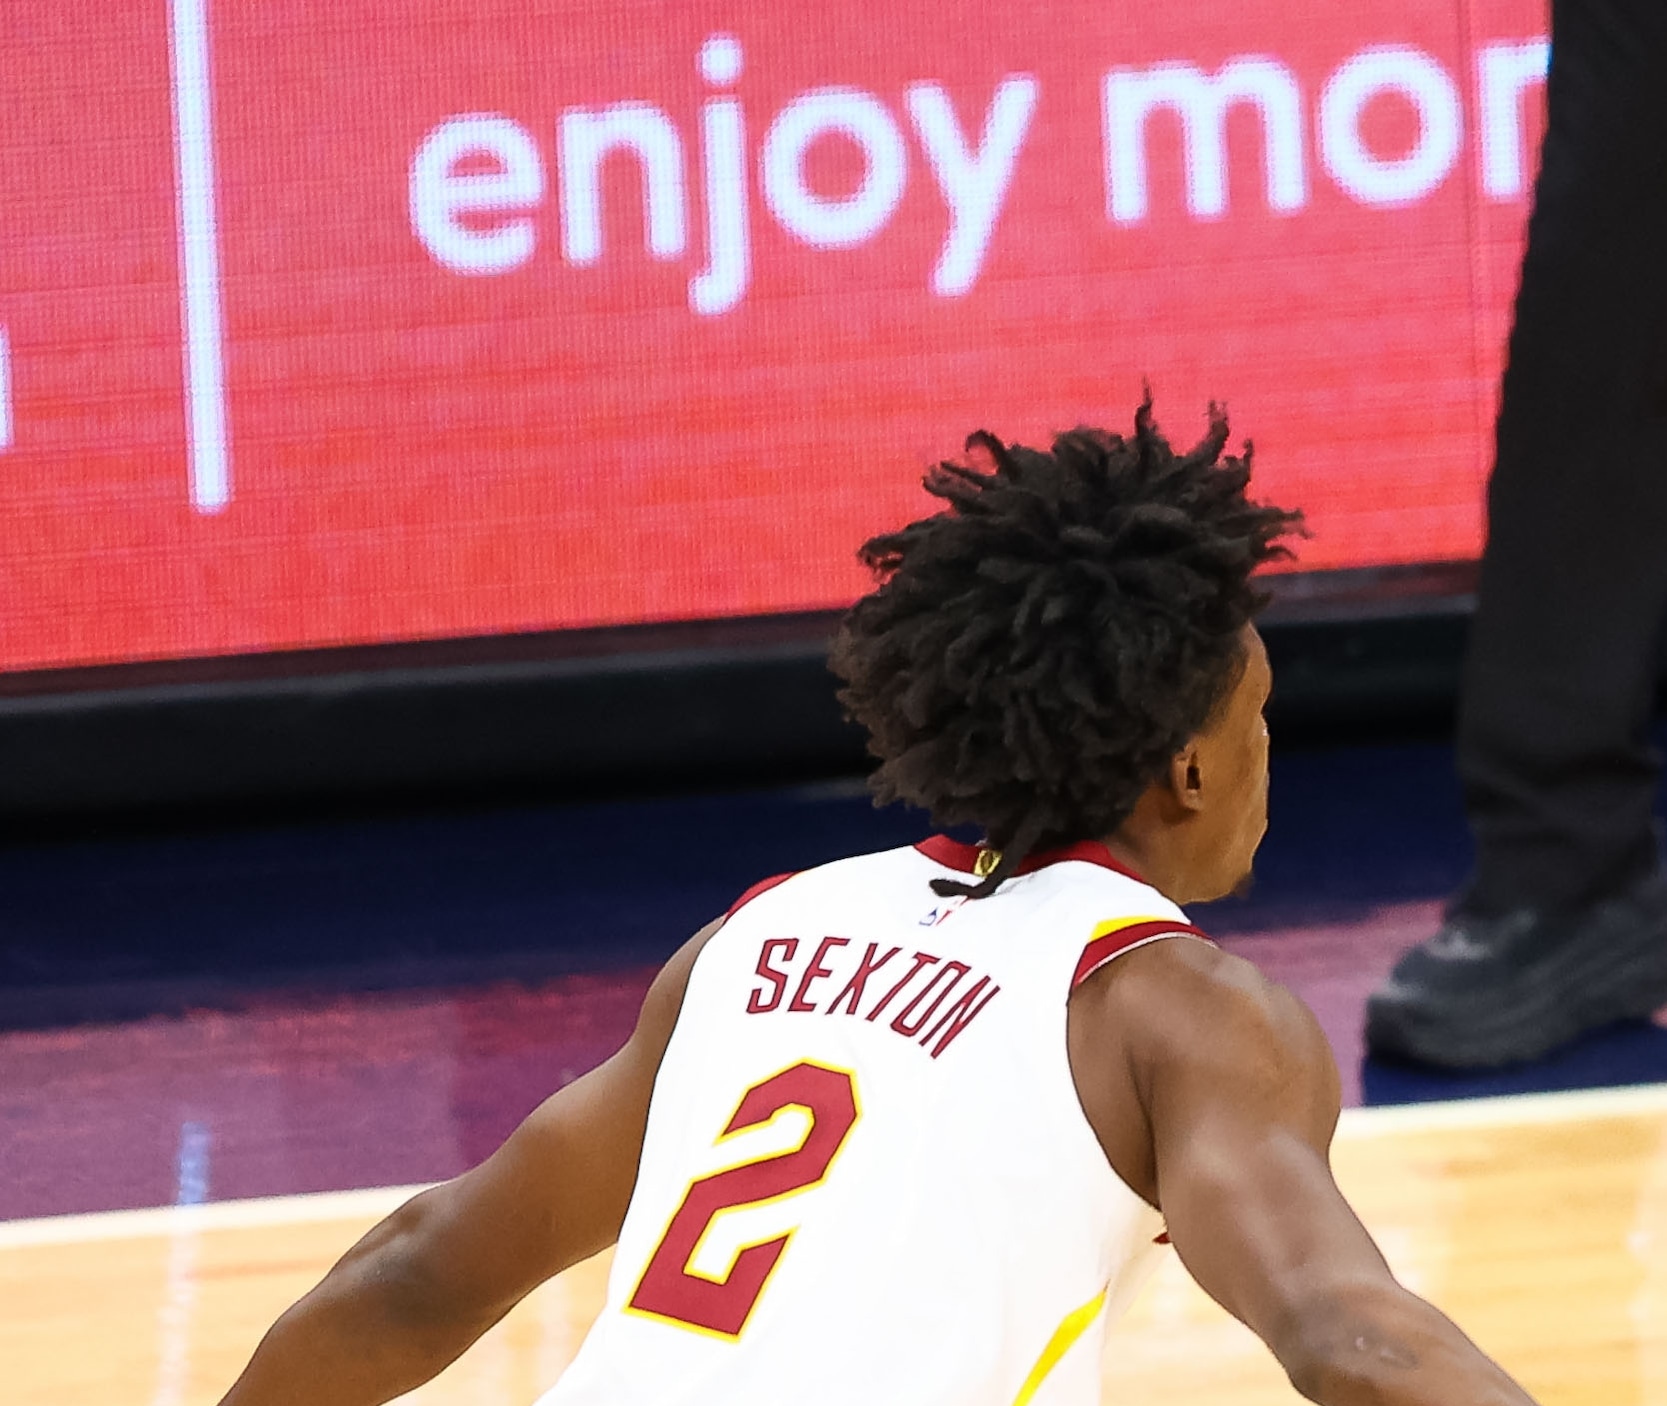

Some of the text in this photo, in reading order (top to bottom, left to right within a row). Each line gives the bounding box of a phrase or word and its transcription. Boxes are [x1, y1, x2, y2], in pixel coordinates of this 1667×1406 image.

[408, 33, 1553, 316] enjoy mor
[745, 936, 1002, 1060] SEXTON
[621, 1056, 864, 1343] 2
